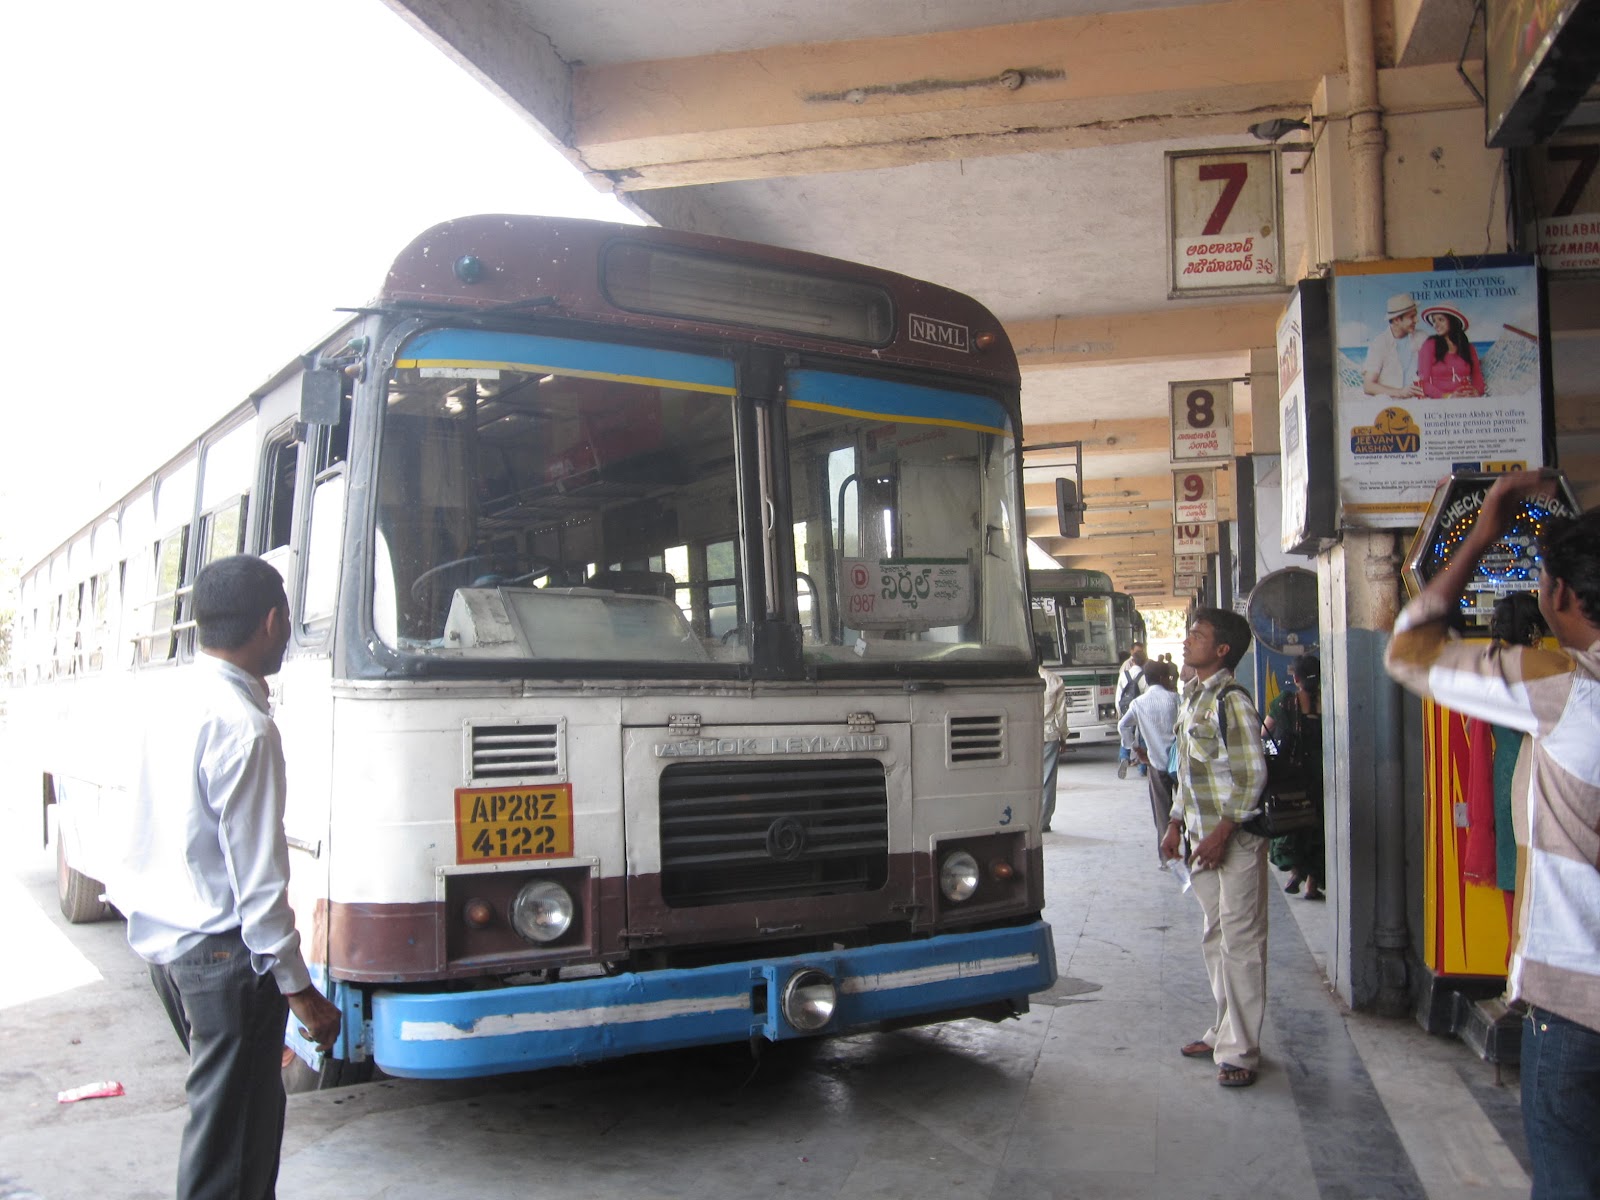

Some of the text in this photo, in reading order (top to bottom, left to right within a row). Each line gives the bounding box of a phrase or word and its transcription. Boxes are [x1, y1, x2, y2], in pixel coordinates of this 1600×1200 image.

[1199, 163, 1248, 235] 7
[1536, 242, 1600, 255] NIZAMABA
[1422, 276, 1505, 289] START ENJOYING
[1410, 291, 1430, 300] THE
[912, 319, 965, 347] NRML
[1186, 389, 1215, 429] 8
[1355, 435, 1394, 445] JEEVAN
[1355, 445, 1394, 453] AKSHAY
[1396, 435, 1417, 452] VI
[1184, 474, 1204, 502] 9
[1440, 490, 1483, 528] CHECK
[854, 569, 866, 586] D
[849, 594, 876, 613] 1987
[1046, 599, 1054, 612] 5
[660, 735, 888, 756] ASHOK LEYLAND
[470, 794, 557, 824] AP28Z
[472, 826, 555, 857] 4122
